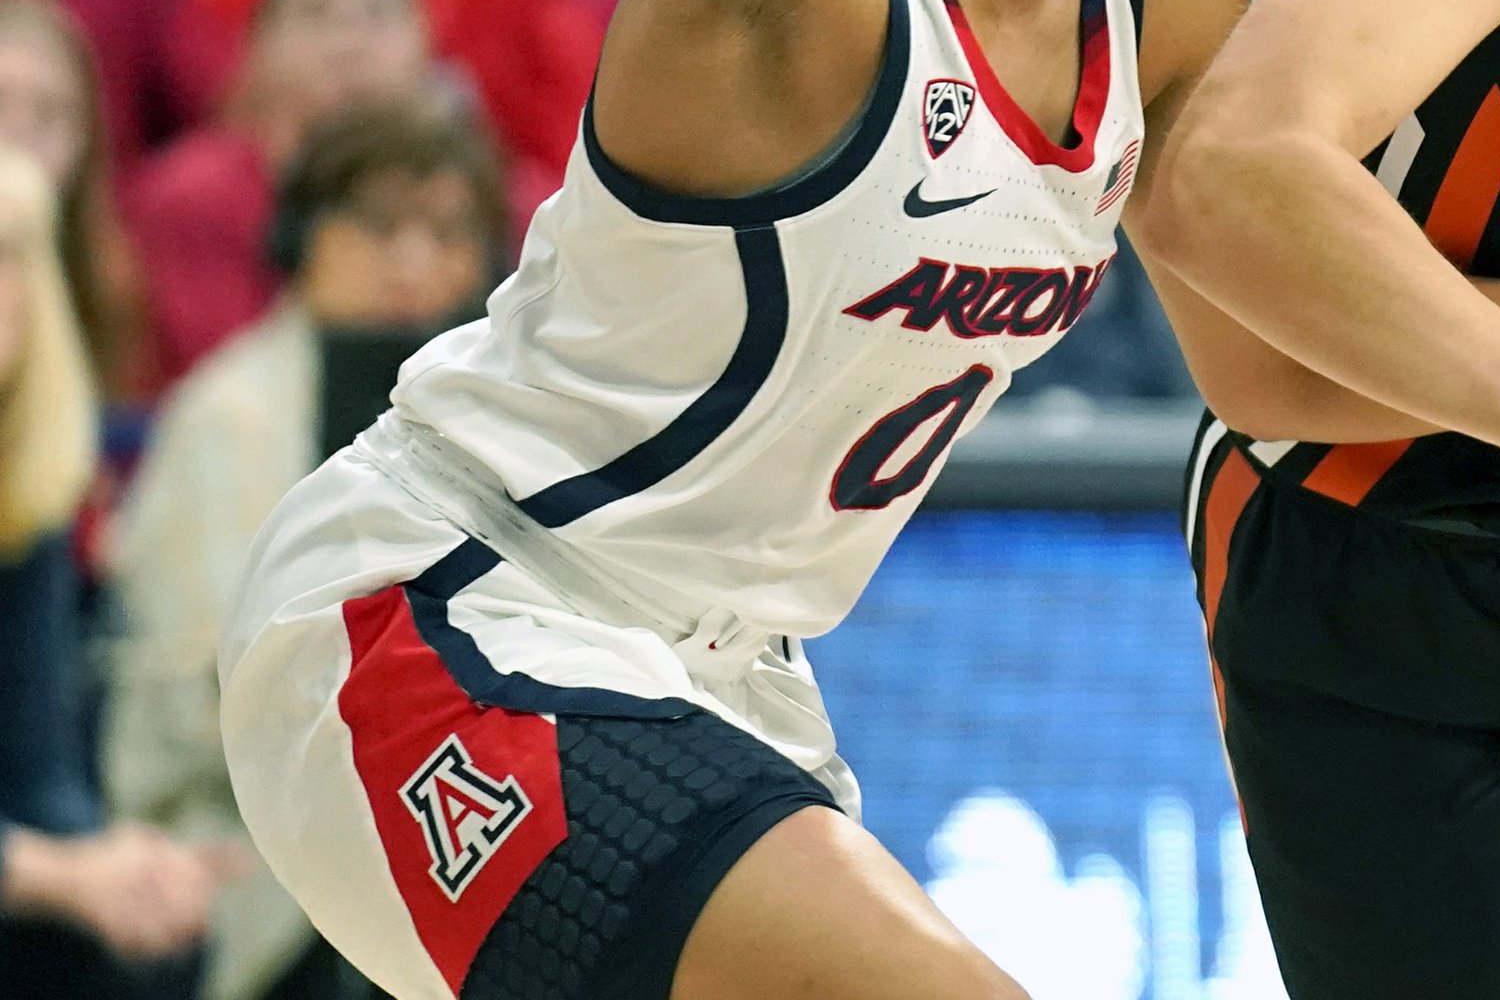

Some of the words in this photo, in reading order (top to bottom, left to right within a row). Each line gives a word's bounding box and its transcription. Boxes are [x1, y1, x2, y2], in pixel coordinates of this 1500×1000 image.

[924, 82, 974, 129] PAC
[928, 111, 957, 142] 12
[841, 253, 1117, 339] ARIZON
[828, 362, 994, 513] 0
[397, 732, 534, 904] A
